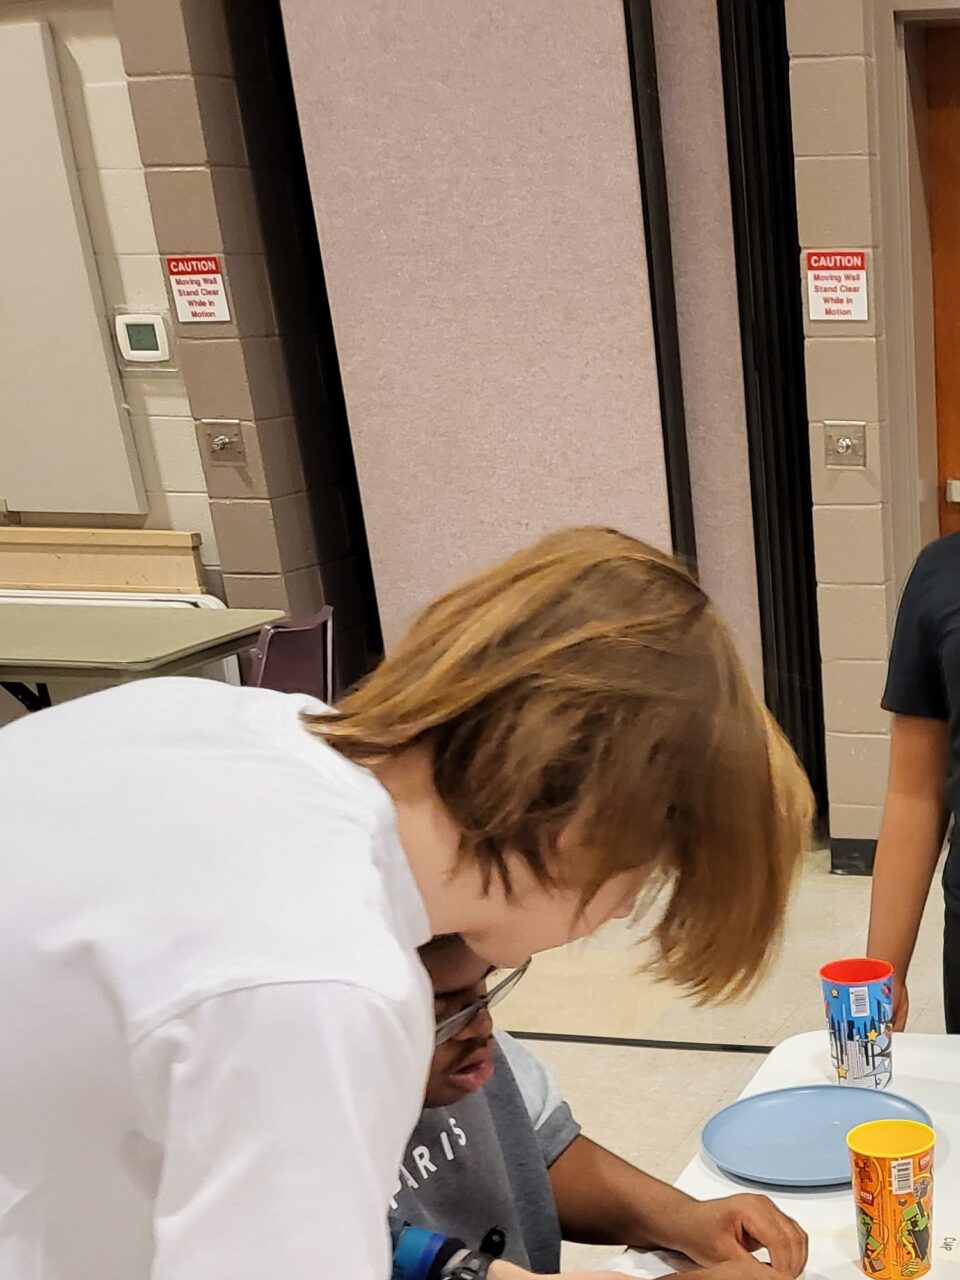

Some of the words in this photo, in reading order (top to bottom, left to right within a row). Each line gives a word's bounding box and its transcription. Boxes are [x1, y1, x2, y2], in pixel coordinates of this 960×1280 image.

[810, 255, 862, 267] CAUTION
[169, 260, 216, 272] CAUTION
[175, 278, 201, 287] Moving
[202, 277, 218, 285] Wall
[813, 273, 842, 283] Moving
[844, 273, 861, 281] Wall
[177, 289, 200, 297] Stand
[200, 288, 219, 296] Clear
[814, 285, 838, 293] Stand
[839, 285, 861, 293] Clear
[186, 299, 208, 307] While
[822, 296, 845, 304] While
[846, 296, 854, 304] in
[190, 310, 216, 318] Motion
[825, 308, 852, 316] Motion
